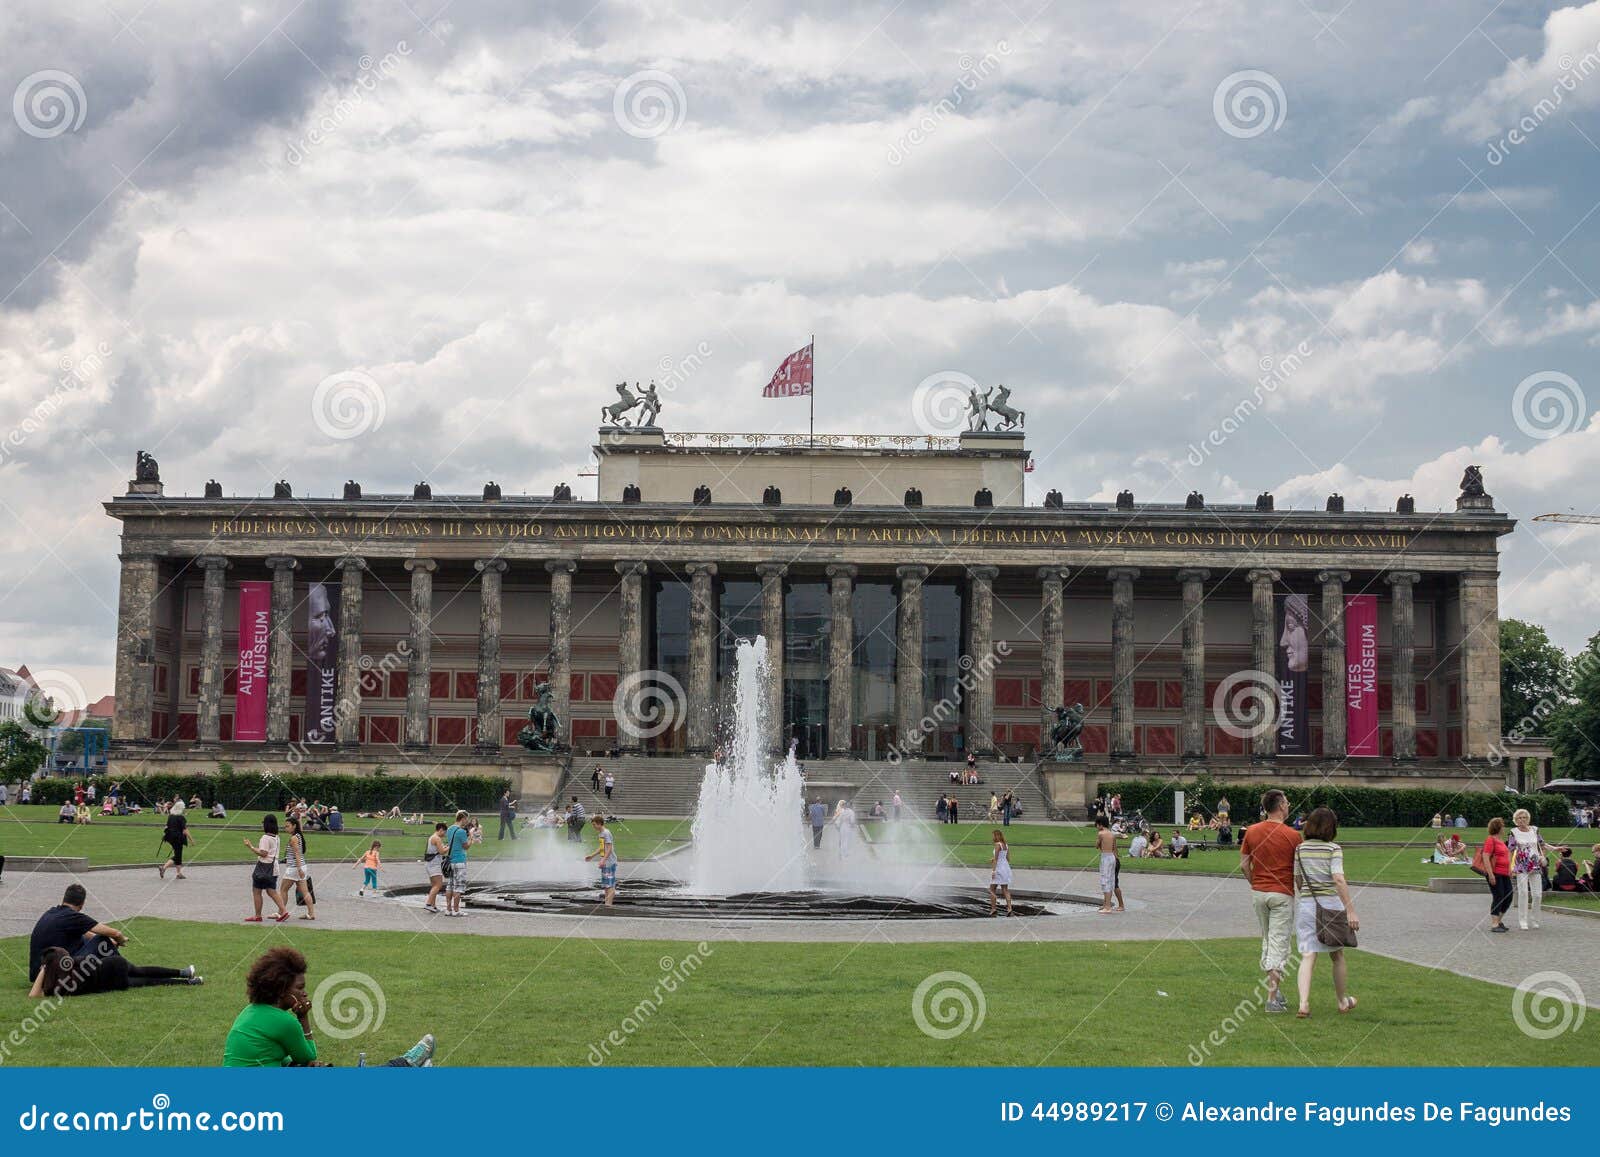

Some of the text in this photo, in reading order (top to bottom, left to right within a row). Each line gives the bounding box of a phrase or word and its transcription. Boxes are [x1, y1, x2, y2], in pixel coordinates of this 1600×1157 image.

[836, 528, 860, 541] ET
[239, 650, 253, 695] ALTES
[254, 611, 269, 678] MUSEUM
[1362, 625, 1376, 692] MUSEUM
[320, 667, 335, 727] ANTIKE
[1280, 680, 1294, 740] ANTIKE
[1348, 664, 1362, 710] ALTES
